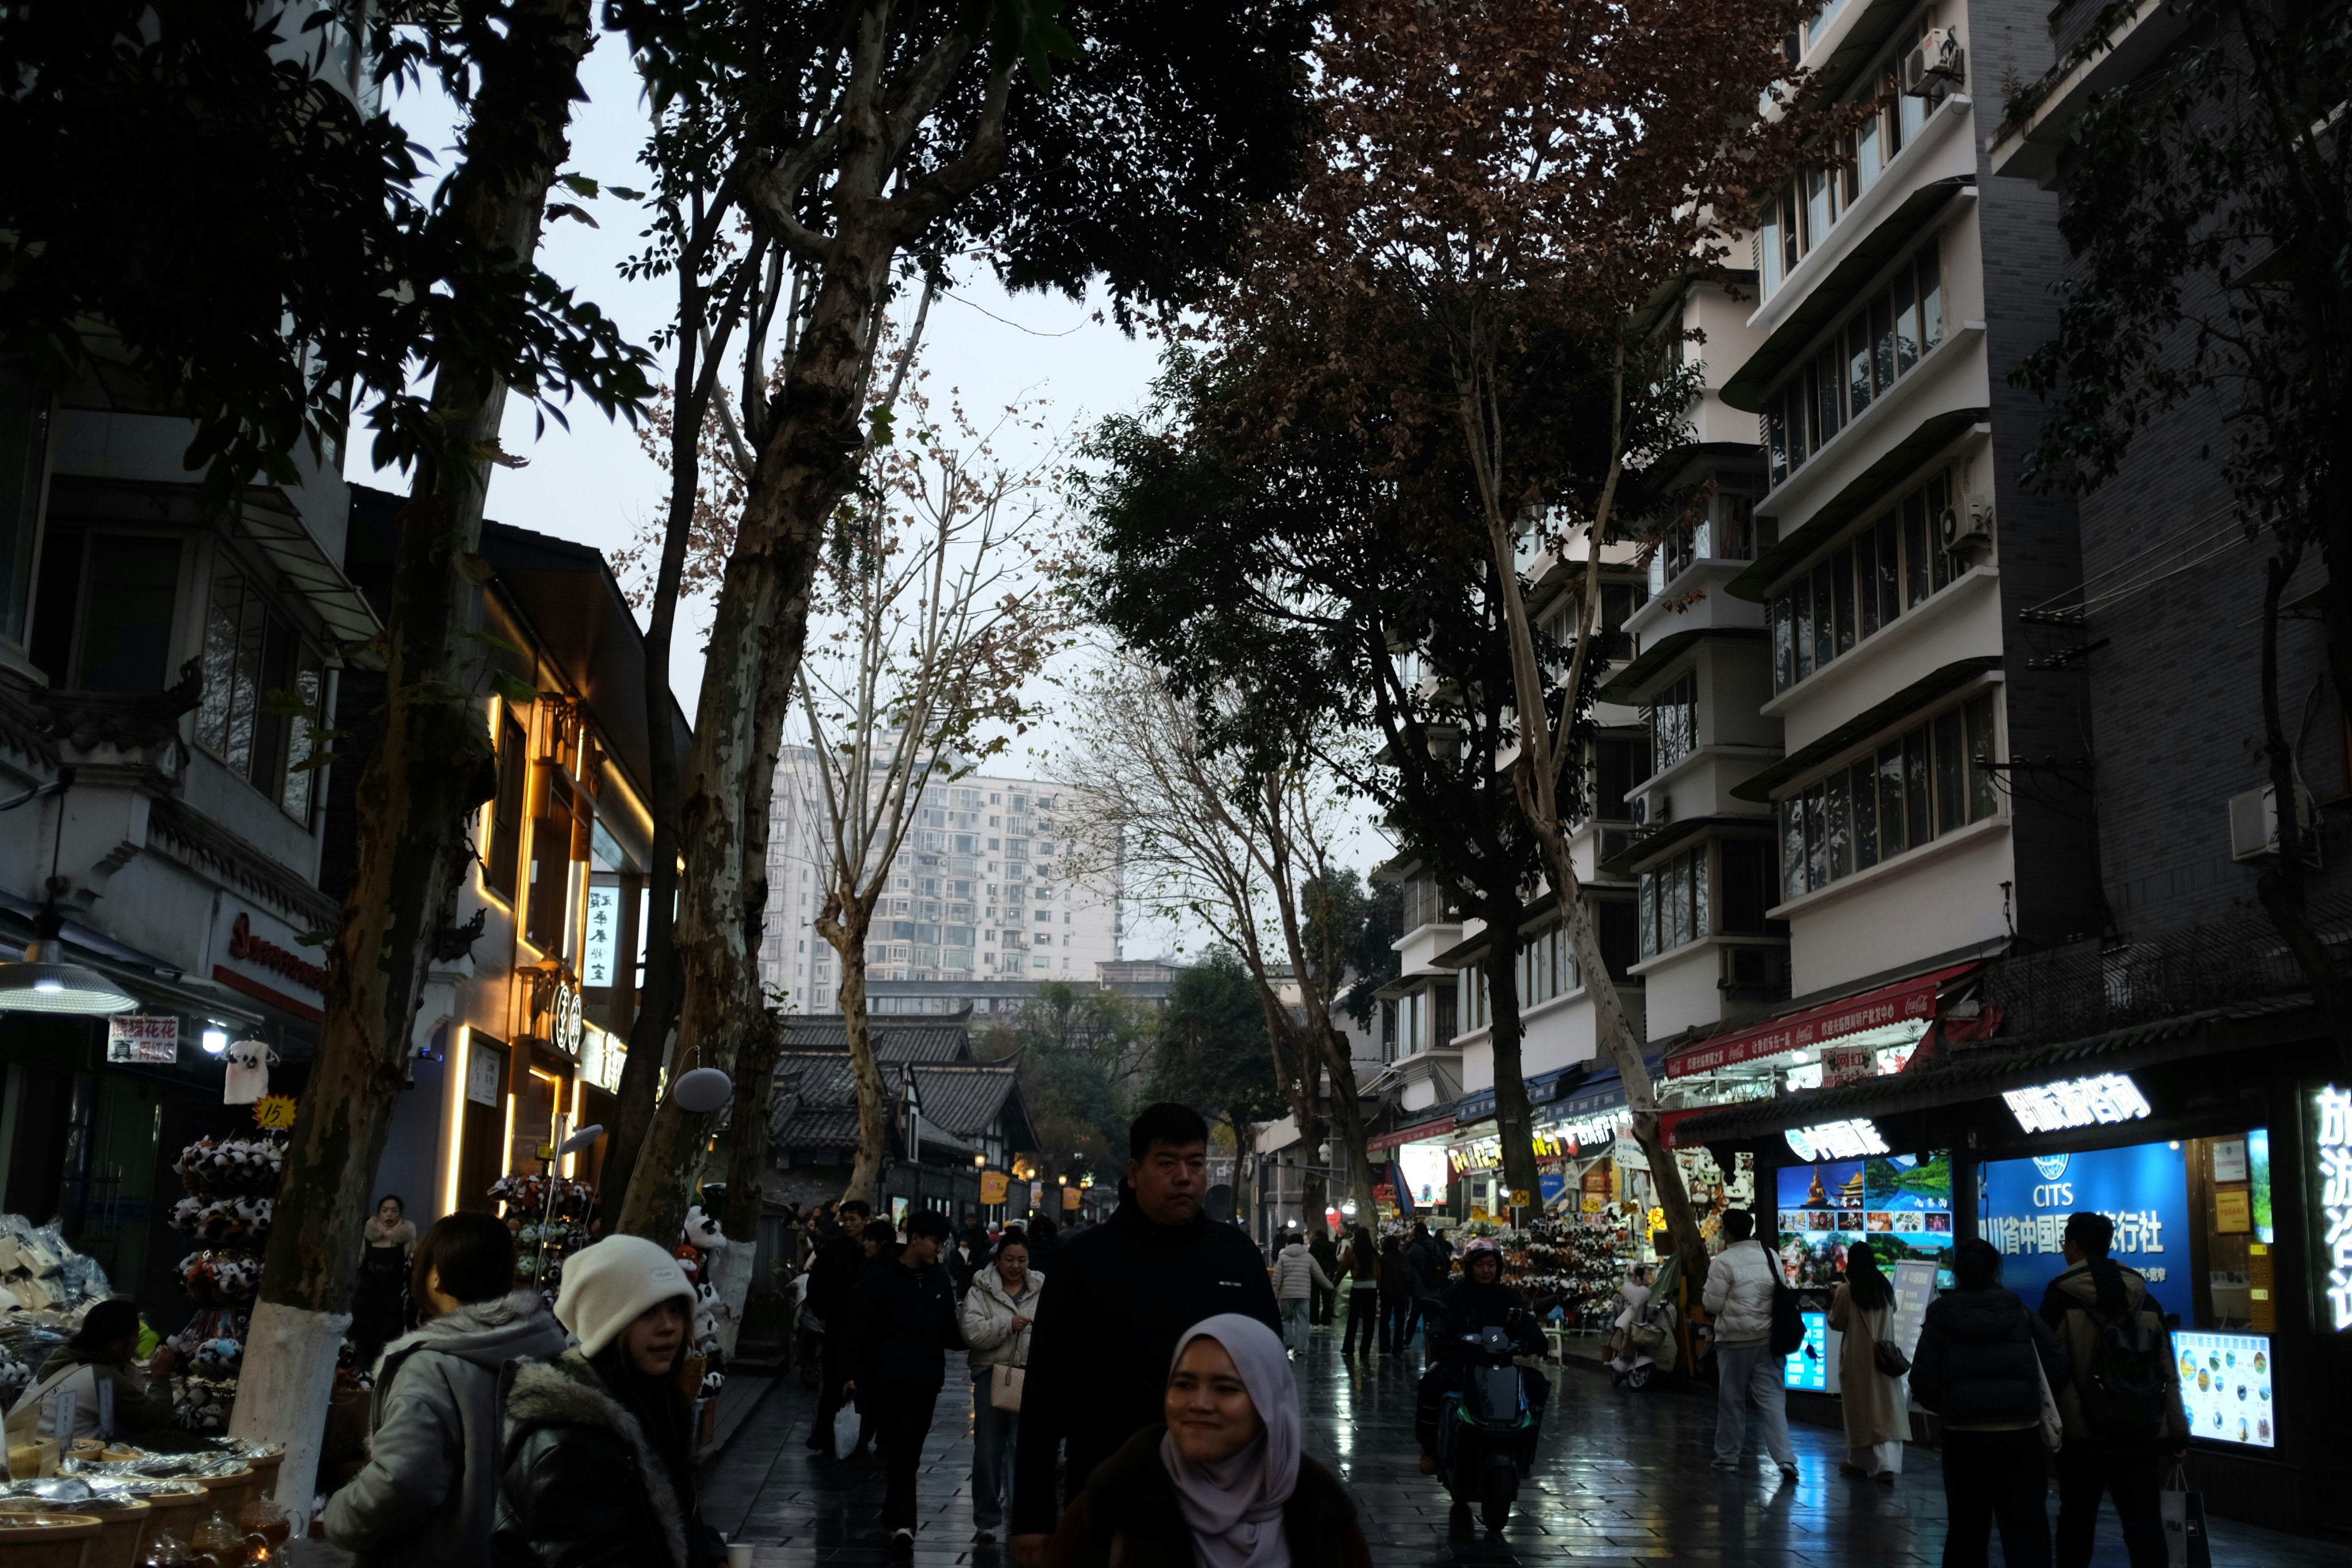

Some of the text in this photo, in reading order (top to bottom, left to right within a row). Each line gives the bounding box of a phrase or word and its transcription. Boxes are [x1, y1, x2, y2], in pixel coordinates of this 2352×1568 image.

[112, 1018, 176, 1038] 熊猫花花
[1821, 1003, 1894, 1036] 欢迎光临四川特产批发中心
[110, 1040, 133, 1060] 真
[1837, 1053, 1863, 1067] 网红
[264, 1102, 282, 1123] 15
[1914, 1197, 1948, 1209] 九寨沟
[2033, 1183, 2074, 1208] CITS
[1978, 1210, 2164, 1255] 川省中国国行社
[2181, 1335, 2267, 1351] 四川省主要旅游线路图
[2167, 1520, 2182, 1532] FILA
